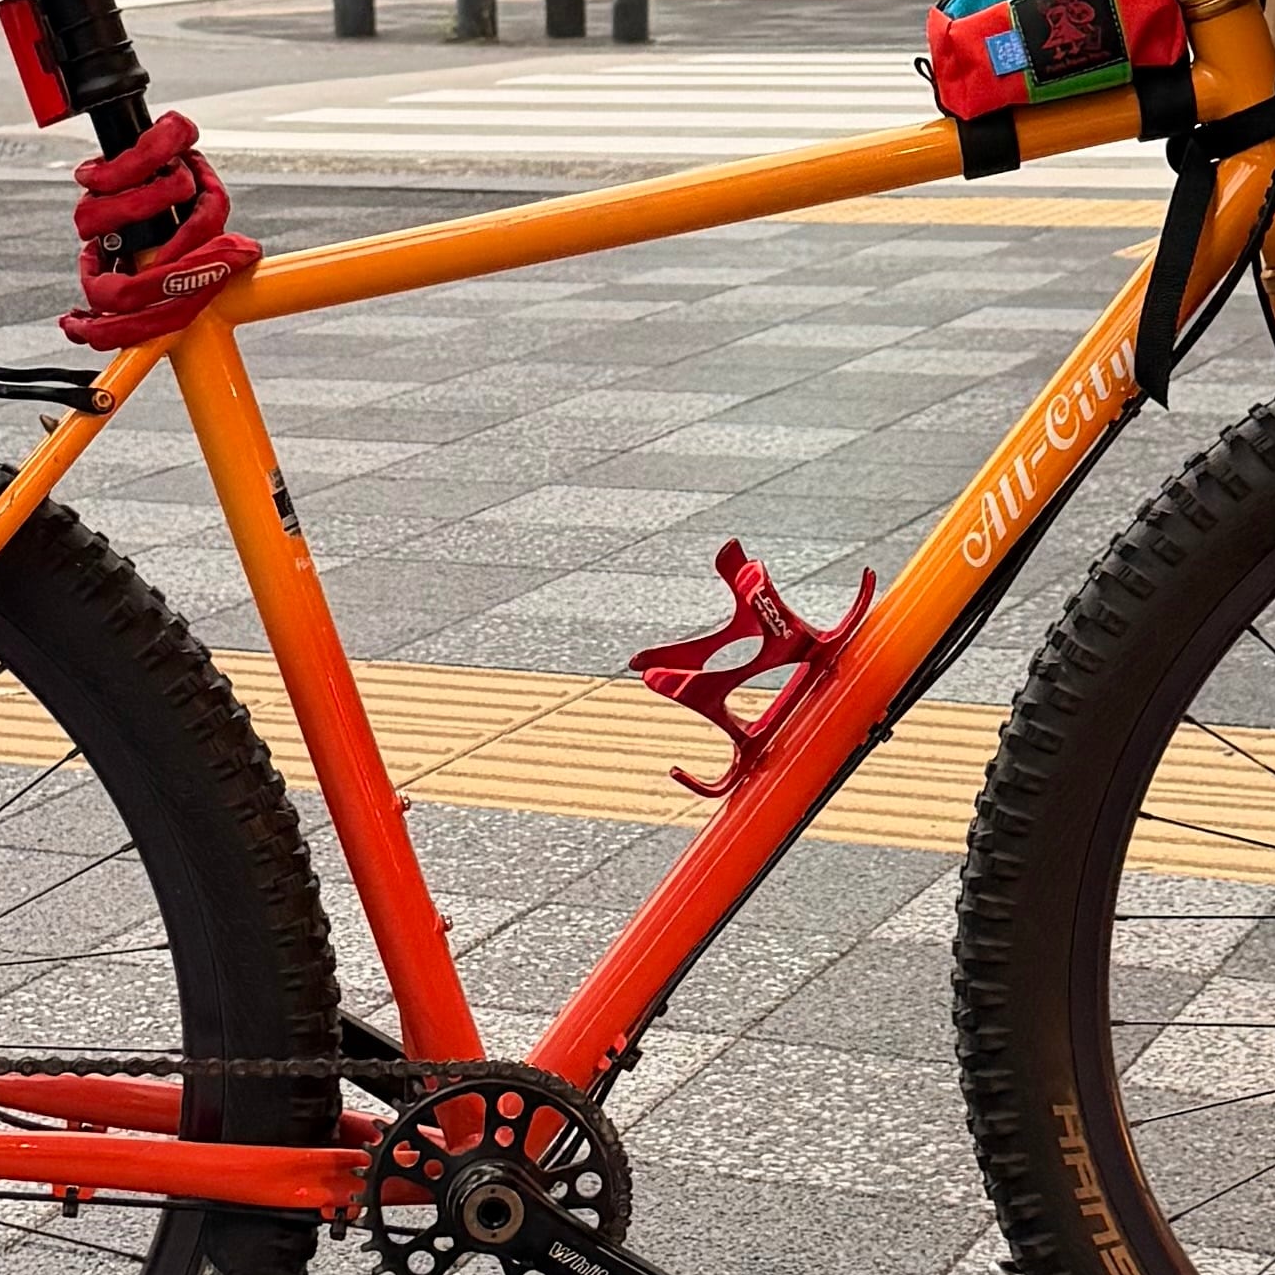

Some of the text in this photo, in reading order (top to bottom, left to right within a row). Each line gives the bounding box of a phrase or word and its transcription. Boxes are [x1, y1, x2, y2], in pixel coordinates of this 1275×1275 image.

[167, 266, 227, 293] ABUS
[961, 335, 1137, 569] All-City
[756, 585, 794, 640] LEZYNE
